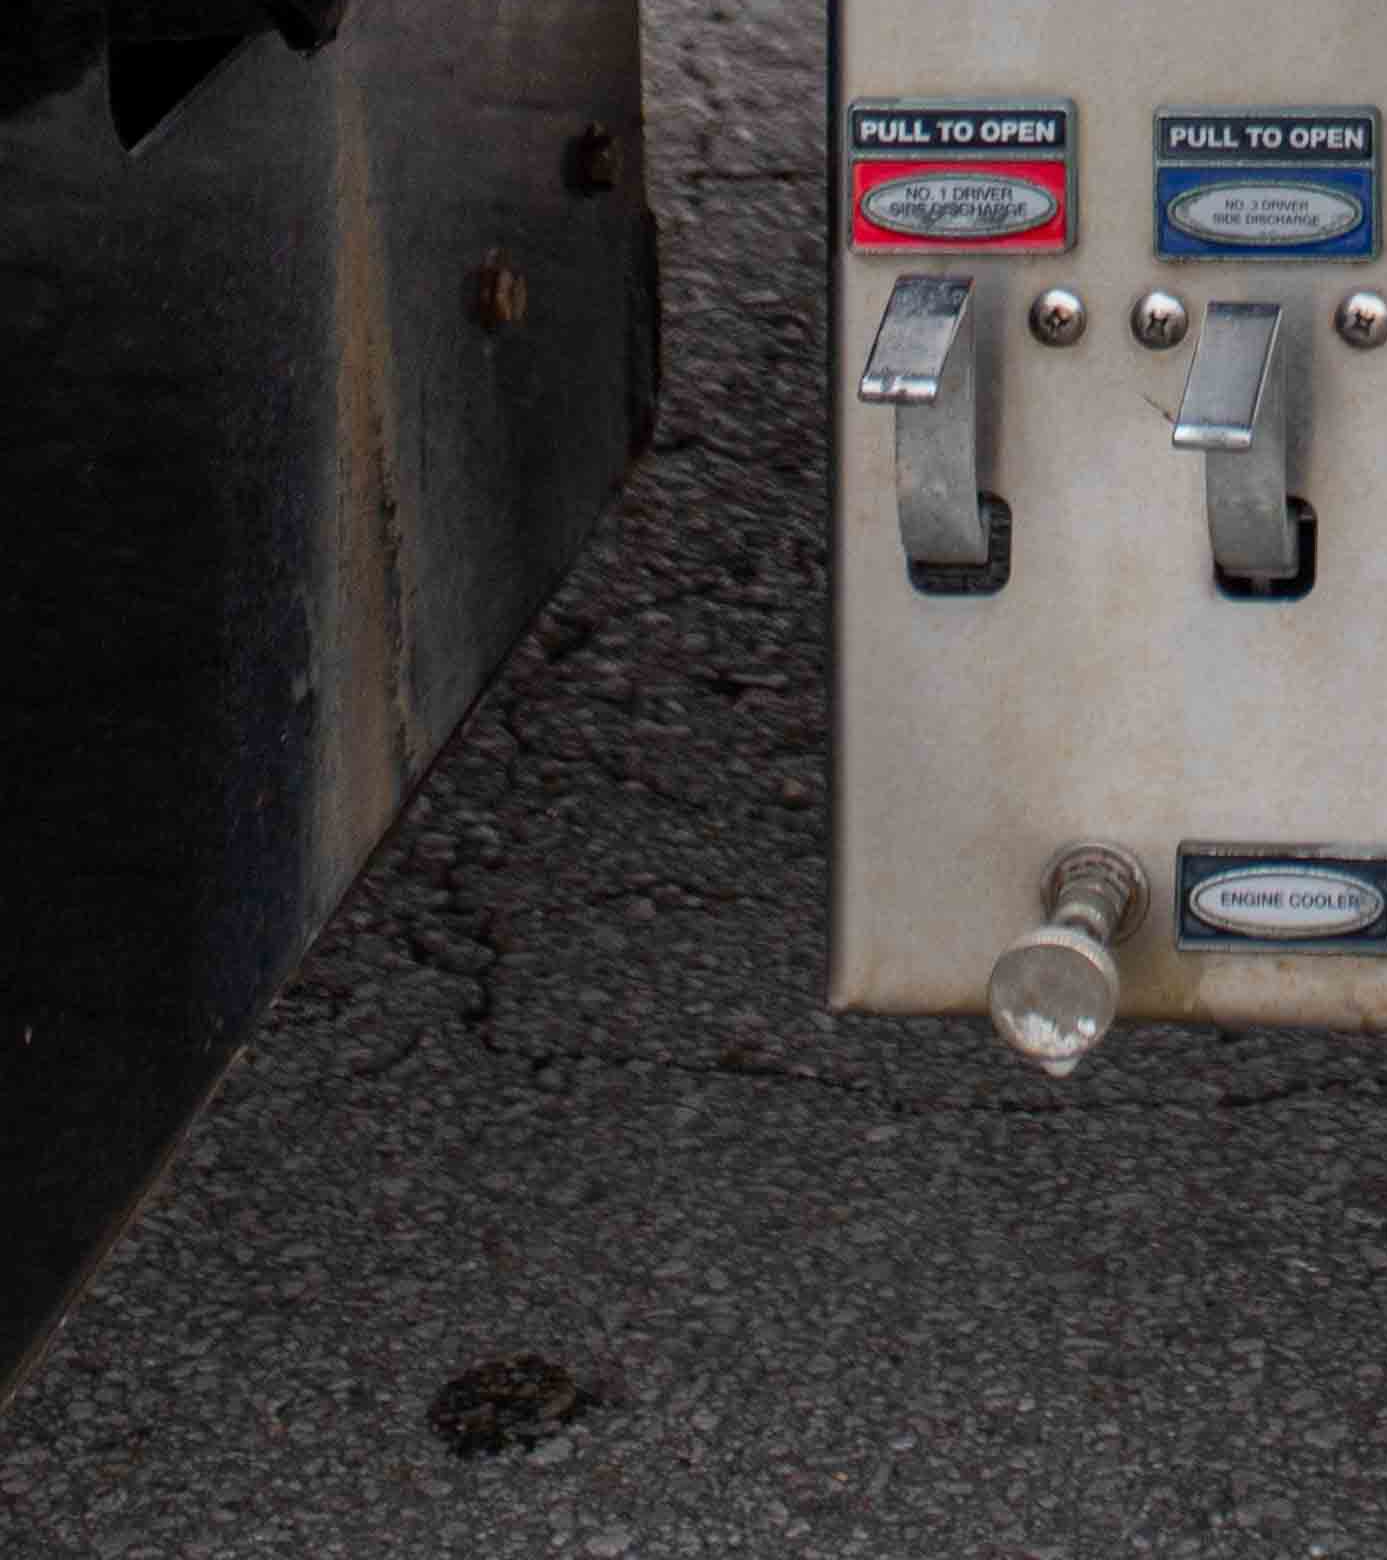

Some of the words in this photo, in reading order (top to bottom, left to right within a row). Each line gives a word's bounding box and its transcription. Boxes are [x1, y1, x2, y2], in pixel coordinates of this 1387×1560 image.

[860, 121, 931, 142] PULL
[936, 121, 974, 142] TO
[980, 121, 1056, 142] OPEN
[1170, 126, 1240, 148] PULL
[1245, 126, 1282, 148] TO
[1289, 127, 1364, 149] OPEN
[905, 187, 936, 201] NO.
[939, 187, 946, 201] 1
[952, 187, 1013, 201] DRIVER
[1261, 199, 1309, 211] DRIVER
[1212, 213, 1242, 225] SIDE
[1246, 213, 1320, 226] DISCHARGE
[1220, 891, 1283, 909] ENGINE
[1288, 892, 1361, 912] COOLER
